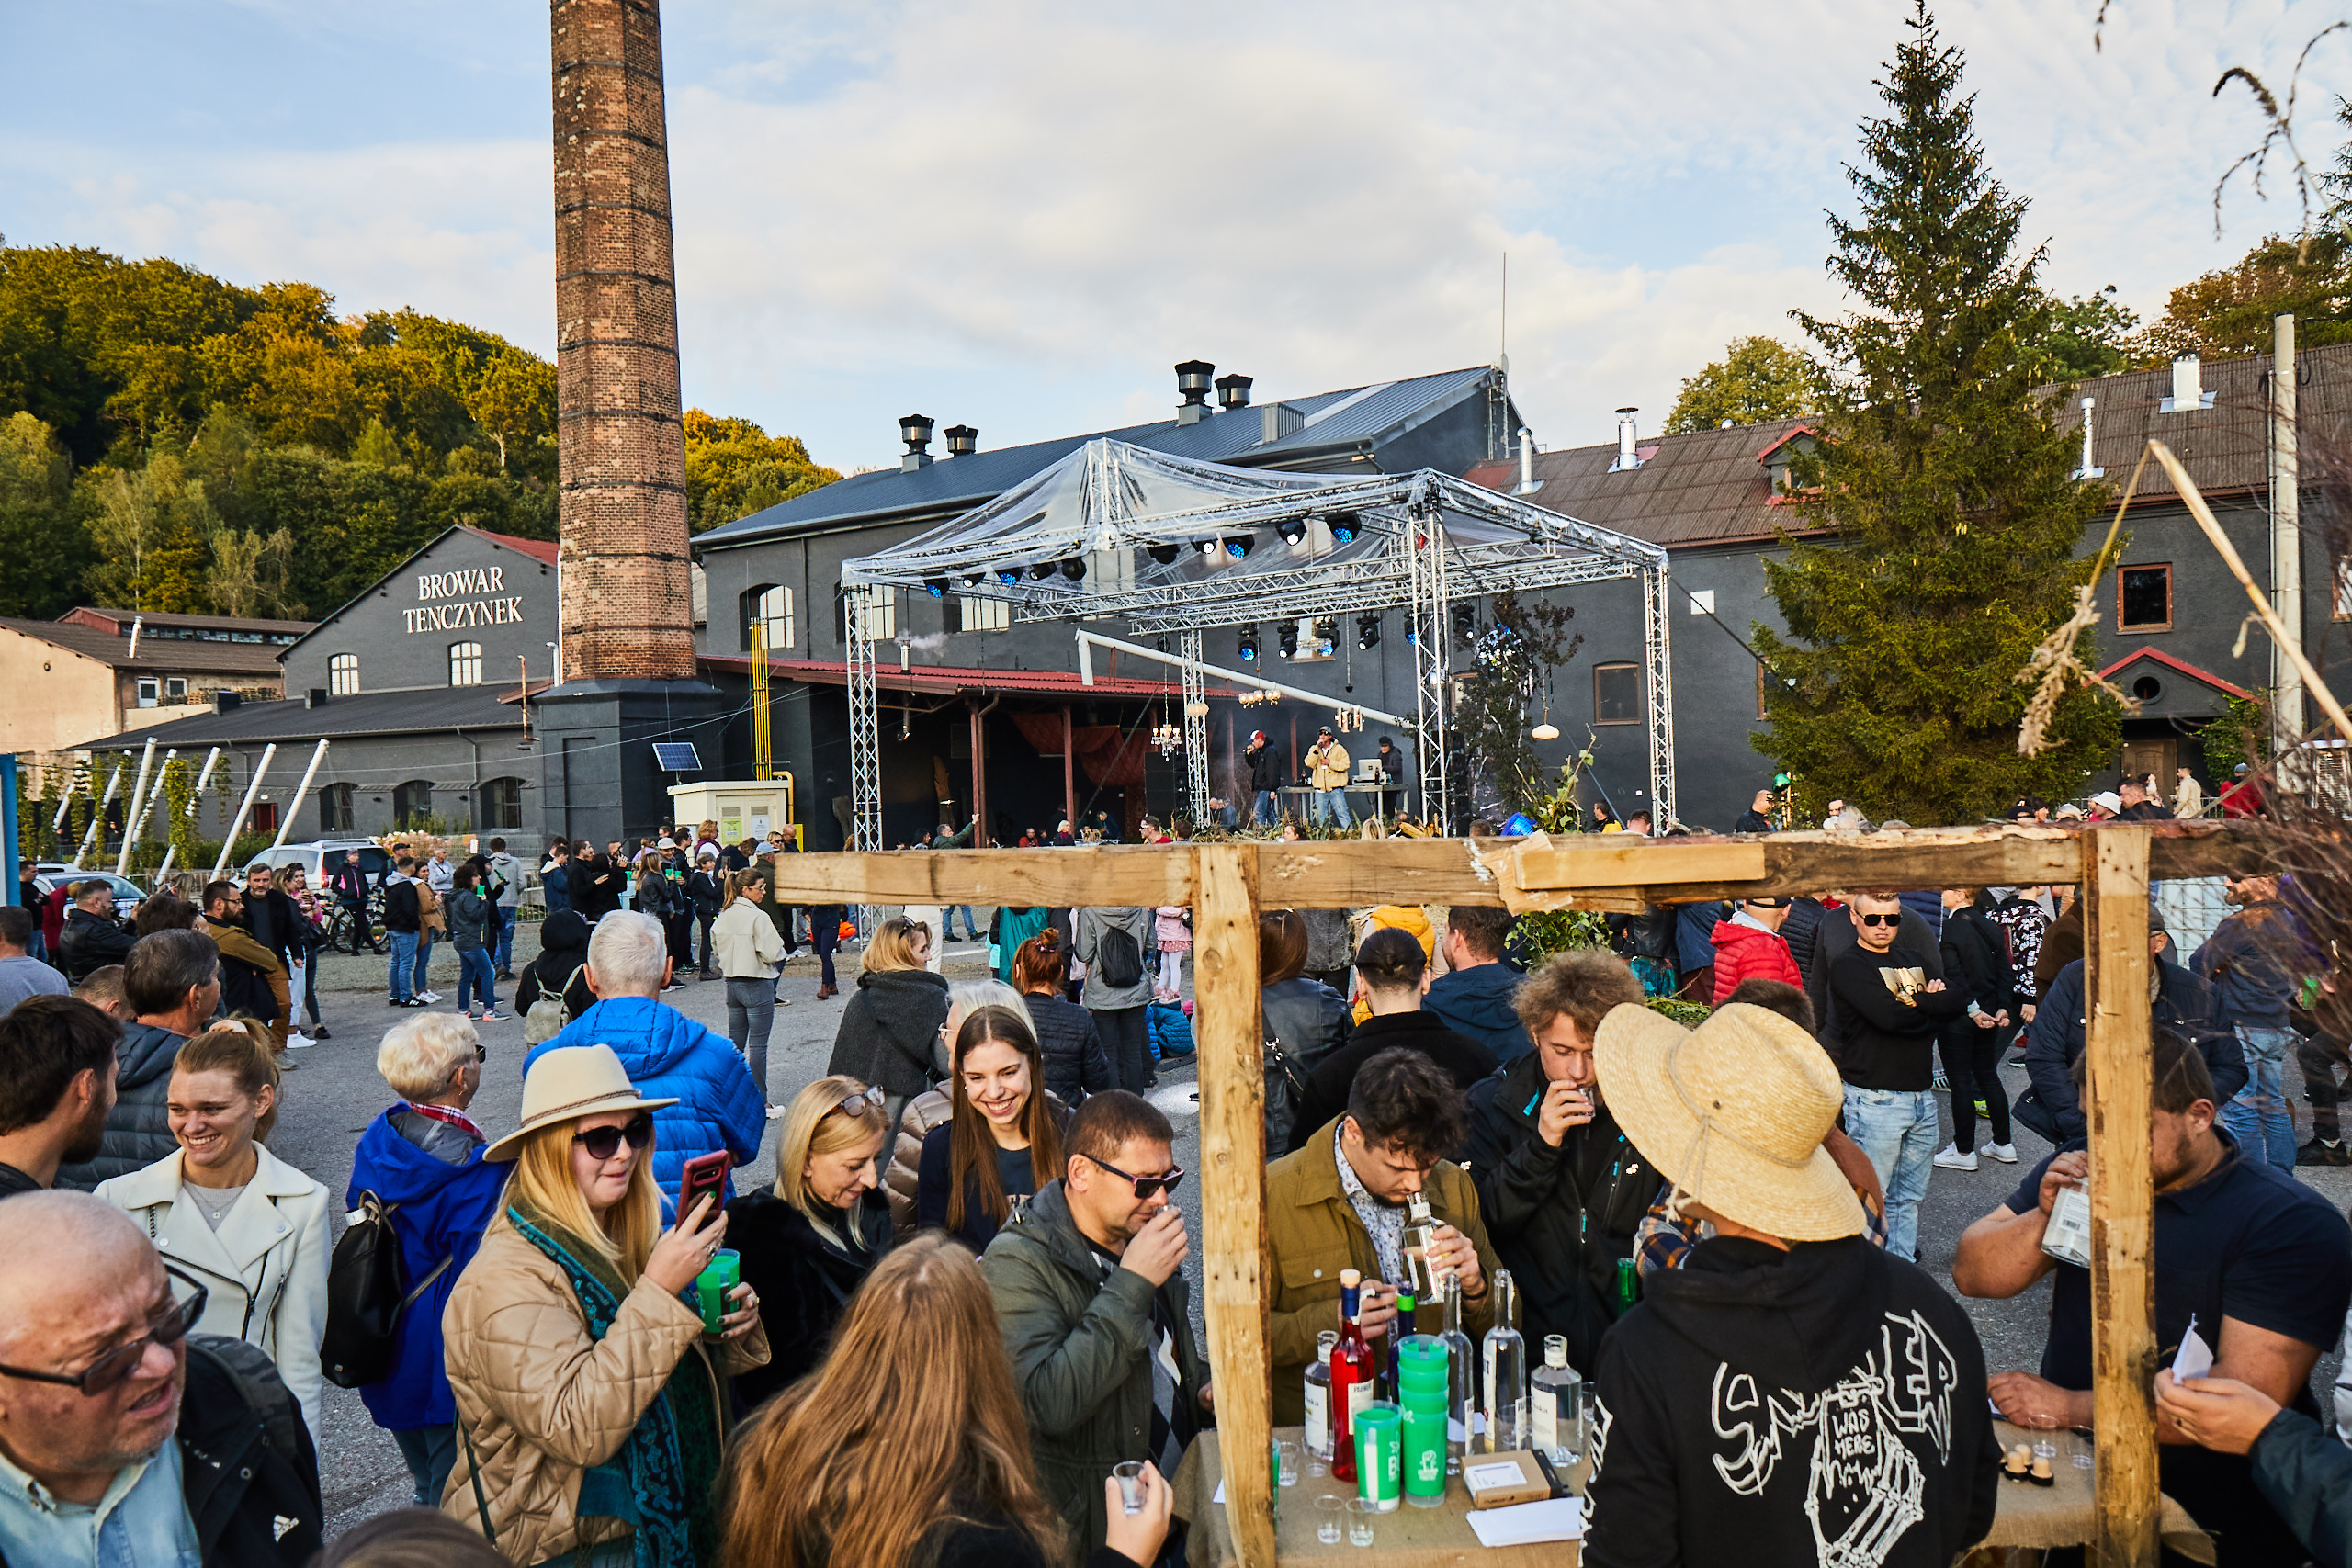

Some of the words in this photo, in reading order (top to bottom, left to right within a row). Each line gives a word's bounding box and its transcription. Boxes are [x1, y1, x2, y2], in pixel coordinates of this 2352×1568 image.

[418, 566, 504, 600] BROWAR
[402, 596, 524, 634] TENCZYNEK
[1831, 1408, 1871, 1438] WAS
[1834, 1433, 1876, 1461] HERE
